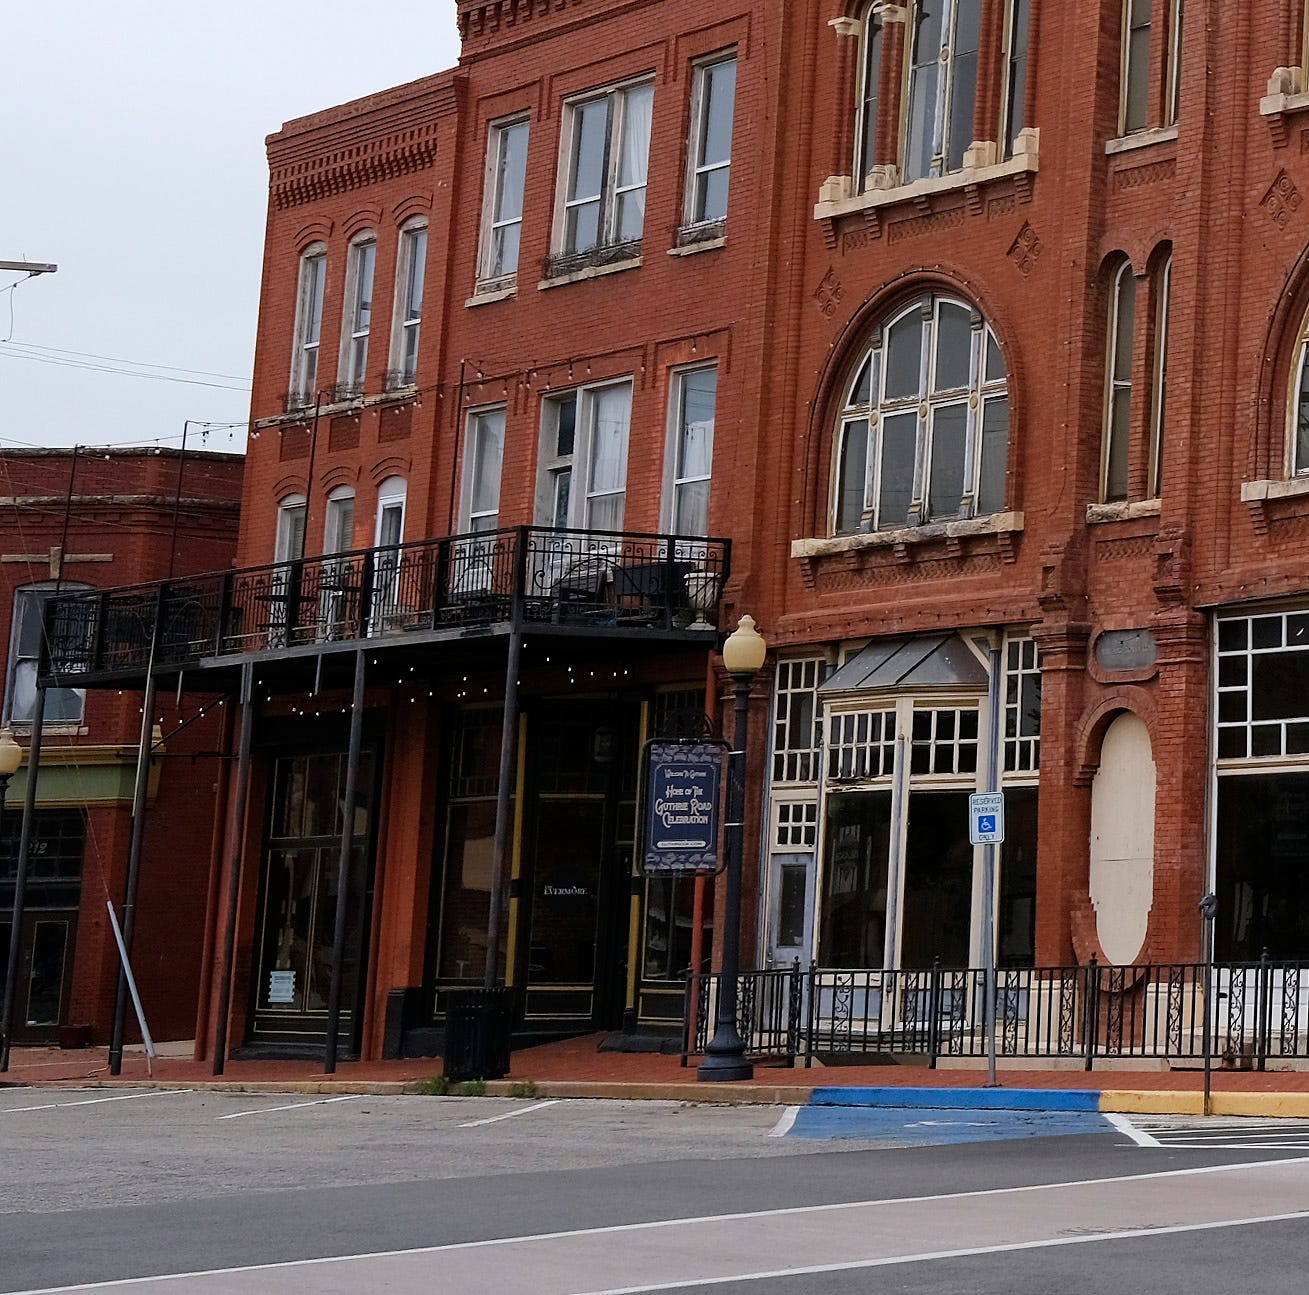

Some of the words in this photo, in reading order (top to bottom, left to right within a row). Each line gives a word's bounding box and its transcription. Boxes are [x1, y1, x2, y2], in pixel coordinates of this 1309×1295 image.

[665, 784, 684, 799] HOME
[684, 788, 692, 796] OF
[655, 798, 689, 816] GUTHRIE
[690, 798, 712, 816] ROAD
[973, 796, 1002, 806] RESERVED
[662, 811, 709, 829] CELEBRATION
